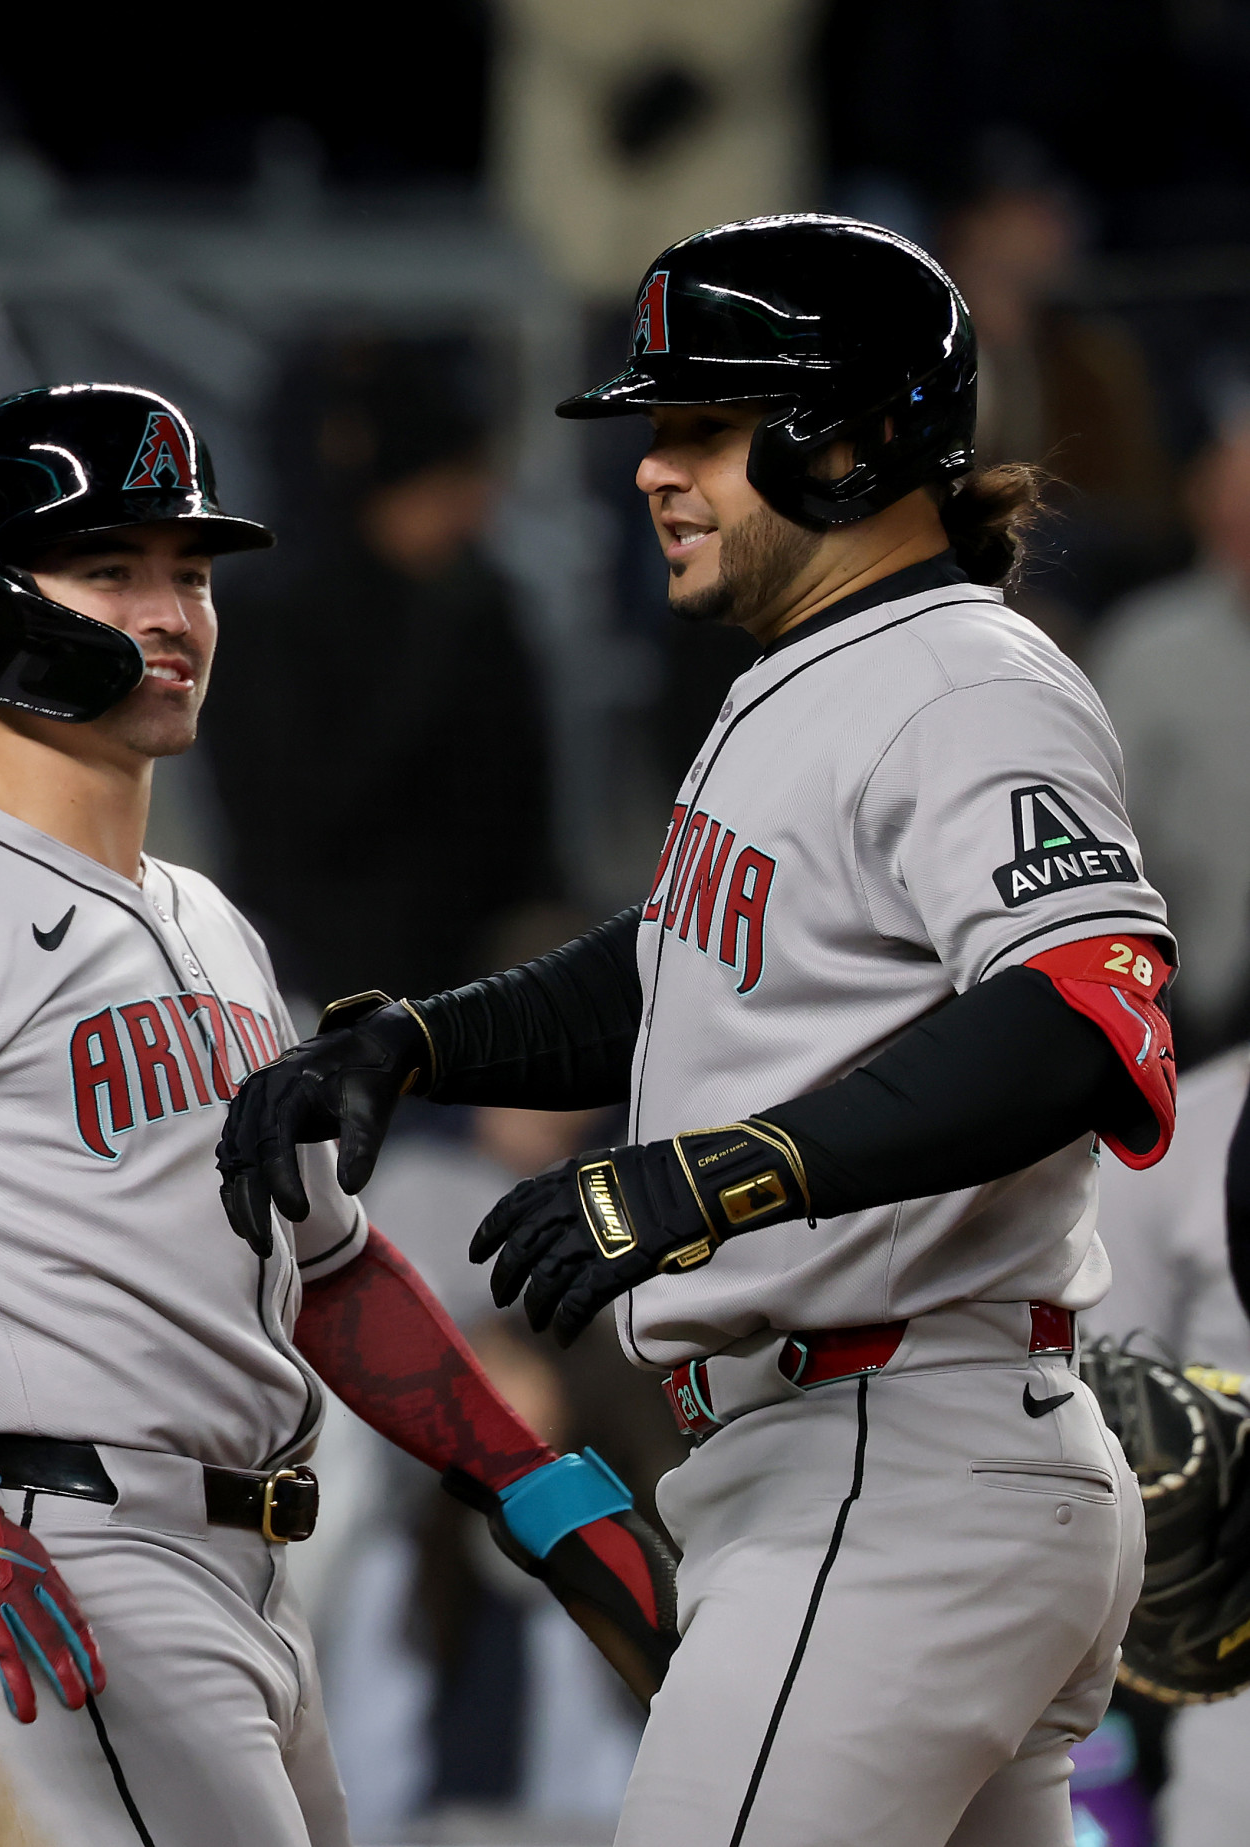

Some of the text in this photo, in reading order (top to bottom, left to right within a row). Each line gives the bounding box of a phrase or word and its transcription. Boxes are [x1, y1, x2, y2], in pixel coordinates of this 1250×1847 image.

[1012, 850, 1122, 899] AVNET
[1103, 942, 1154, 987] 28
[68, 987, 281, 1162] ARIZO
[677, 1384, 699, 1420] 28
